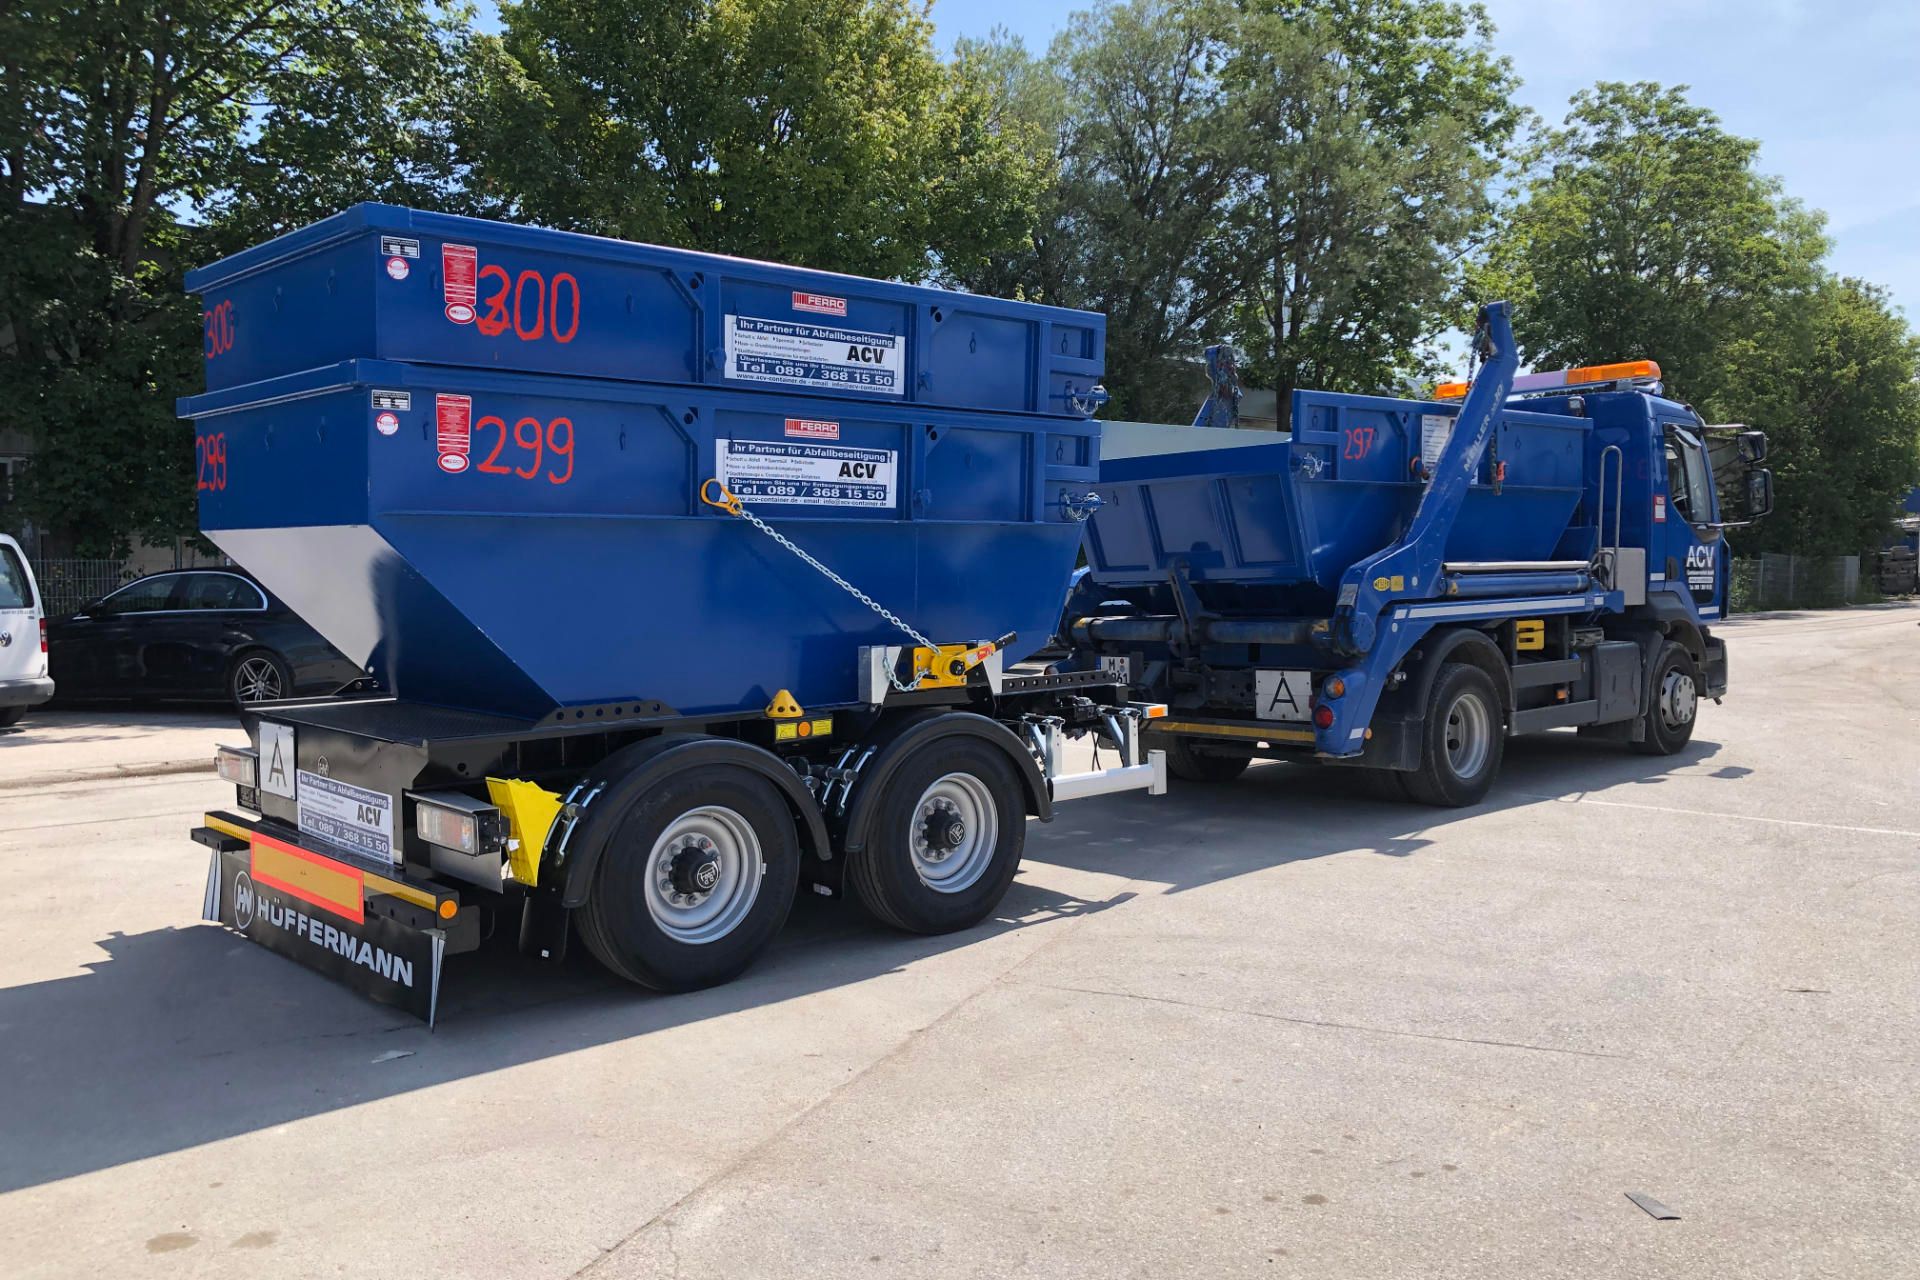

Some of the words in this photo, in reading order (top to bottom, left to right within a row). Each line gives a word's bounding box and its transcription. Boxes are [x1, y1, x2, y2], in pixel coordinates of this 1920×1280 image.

[476, 264, 580, 342] 300
[808, 296, 845, 308] FERRO
[740, 320, 754, 329] Ihr
[757, 322, 794, 334] Partner
[796, 327, 810, 336] für
[812, 329, 893, 348] Abfallbeseitigung
[847, 346, 884, 364] ACV
[740, 362, 770, 373] Tel.
[775, 366, 804, 376] 089
[808, 368, 816, 378] /
[821, 370, 848, 380] 368
[854, 374, 870, 383] 15
[875, 376, 892, 386] 50
[800, 422, 838, 432] FERRO
[476, 416, 574, 484] 299
[748, 444, 785, 454] Partner
[788, 447, 802, 455] für
[804, 448, 886, 462] Abfallbeseitigung
[1344, 428, 1374, 460] 297
[195, 432, 226, 492] 299
[838, 462, 876, 478] ACV
[731, 484, 762, 494] Tel.
[767, 486, 796, 496] 089
[800, 488, 808, 496] /
[812, 488, 840, 498] 368
[845, 490, 862, 498] 15
[866, 490, 884, 500] 50
[1686, 546, 1714, 568] ACV
[1270, 676, 1299, 714] A
[268, 733, 287, 789] A
[301, 774, 309, 782] Ihr
[310, 777, 328, 788] Partner
[328, 782, 336, 792] für
[357, 804, 382, 826] ACV
[318, 822, 334, 834] 089
[343, 830, 360, 844] 368
[362, 836, 373, 848] 15
[376, 841, 388, 852] 50
[257, 898, 412, 988] HÜFFERMANN
